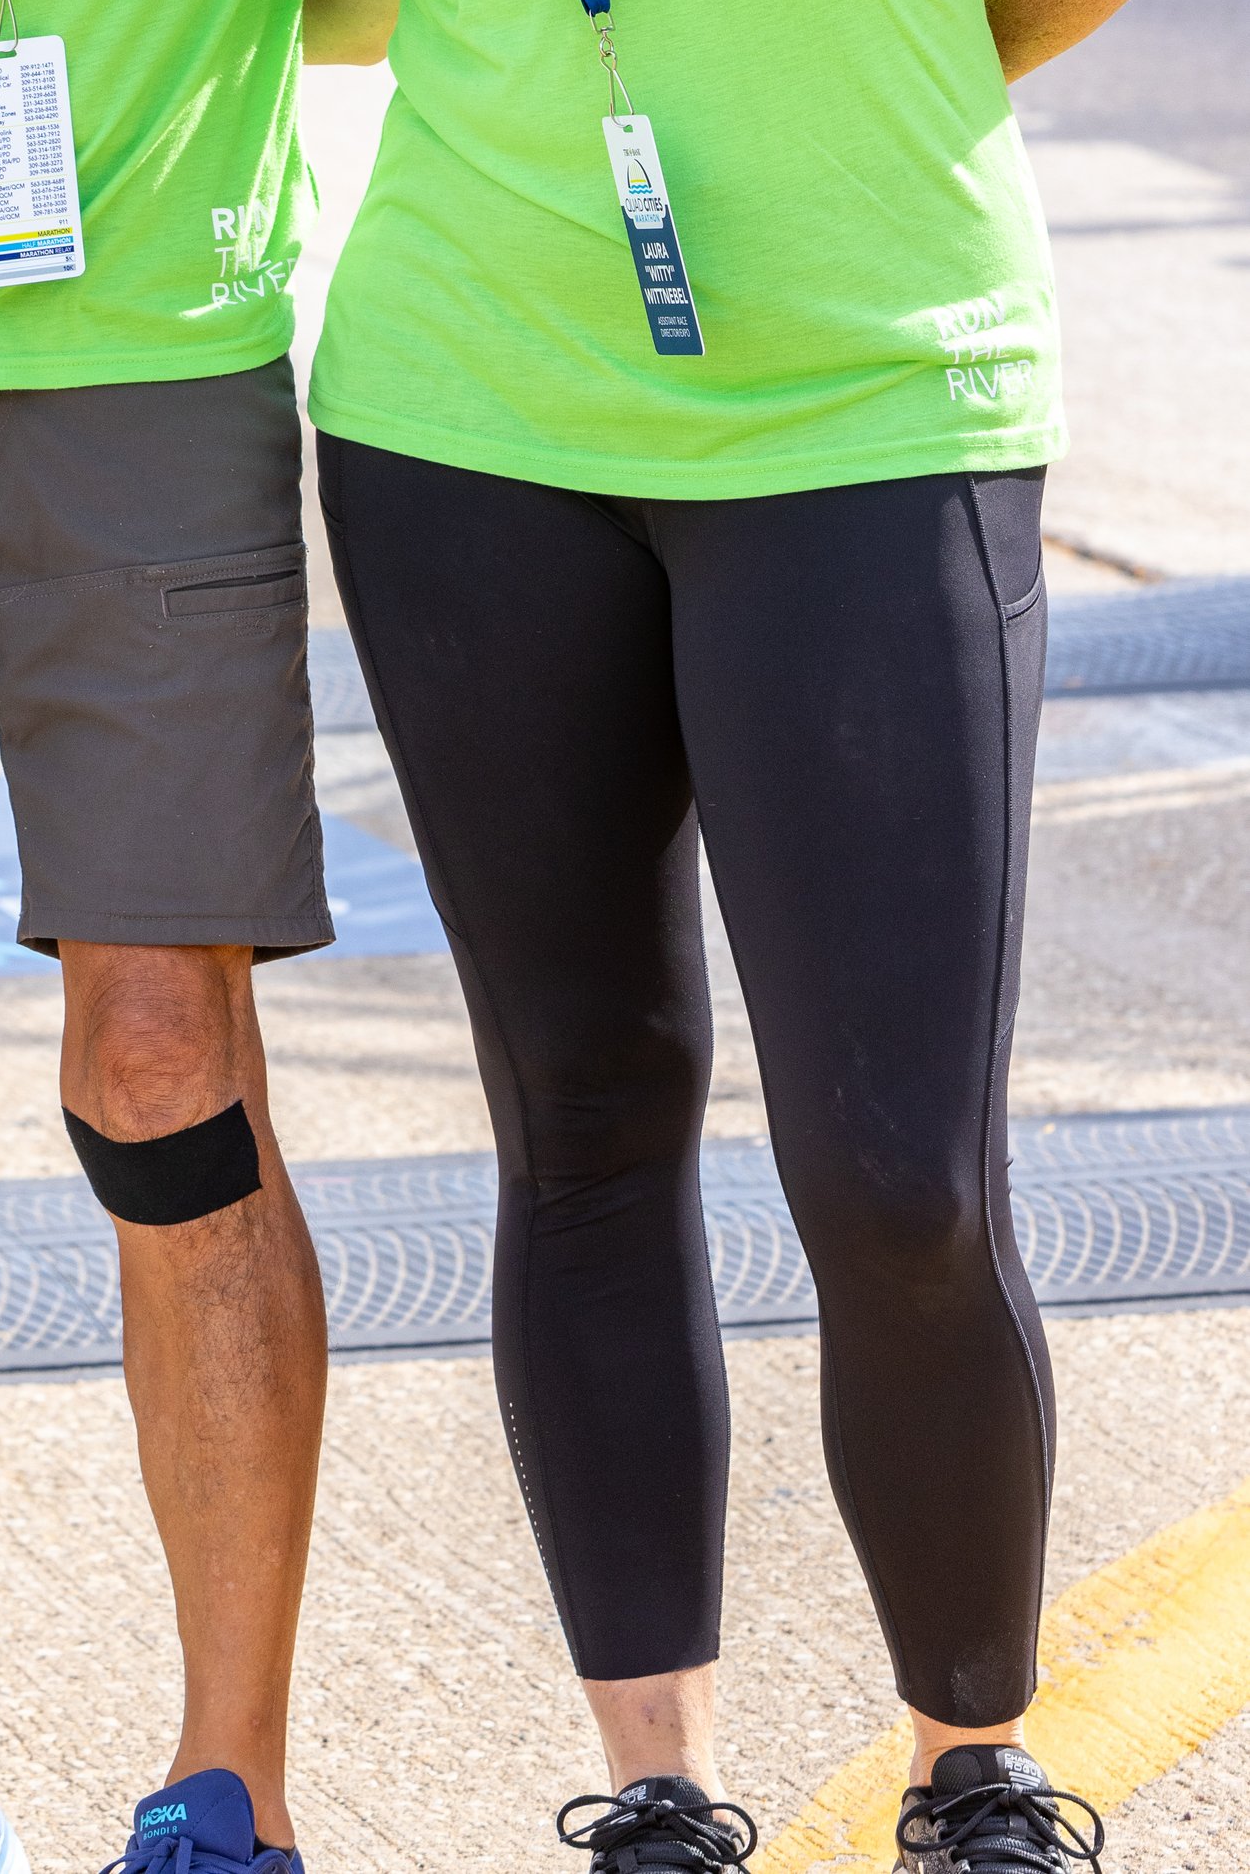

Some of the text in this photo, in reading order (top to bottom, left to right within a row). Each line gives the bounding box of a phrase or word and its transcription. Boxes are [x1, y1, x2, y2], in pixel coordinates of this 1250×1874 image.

[625, 197, 663, 212] QUAD CITIES
[37, 227, 70, 237] MARATHON
[37, 236, 70, 246] MARATHON
[19, 248, 54, 257] MARATHON
[642, 242, 669, 259] LAURA
[644, 287, 689, 304] WITTNEBEL
[932, 290, 1006, 341] RUN
[945, 359, 1036, 402] RIVER
[140, 1803, 187, 1832] HOKA
[143, 1826, 178, 1841] BONDI 8
